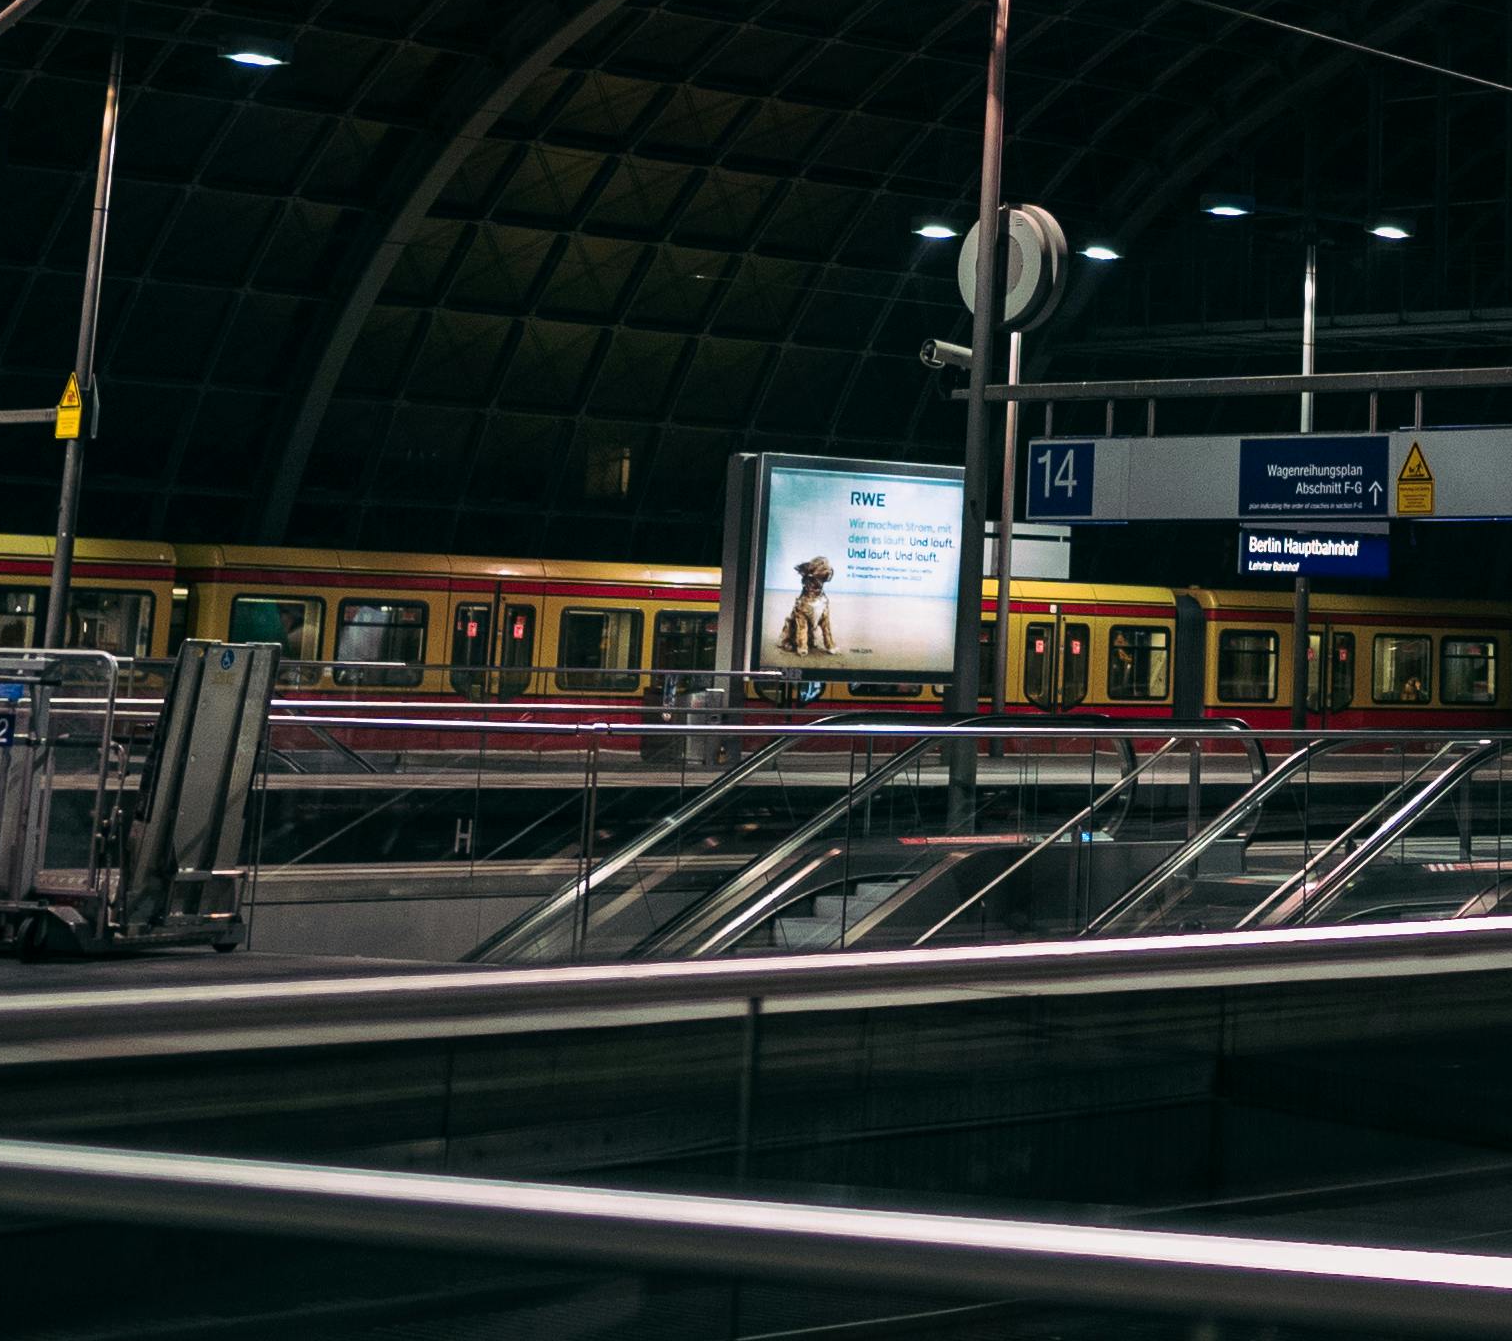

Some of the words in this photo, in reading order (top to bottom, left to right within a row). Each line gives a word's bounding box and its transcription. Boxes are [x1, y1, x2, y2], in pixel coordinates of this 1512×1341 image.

[1036, 448, 1078, 499] 14
[1267, 464, 1363, 480] Wagenreihungsplan
[1295, 480, 1342, 495] Abschnitt
[1344, 480, 1363, 495] F-G
[849, 491, 887, 508] RWE
[848, 517, 865, 529] Wir
[848, 533, 869, 544] dem
[909, 537, 928, 547] Und
[1248, 535, 1282, 554] Berlin
[1283, 537, 1360, 558] Hauptbahnhof
[847, 547, 866, 559] Und
[454, 817, 473, 854] H
